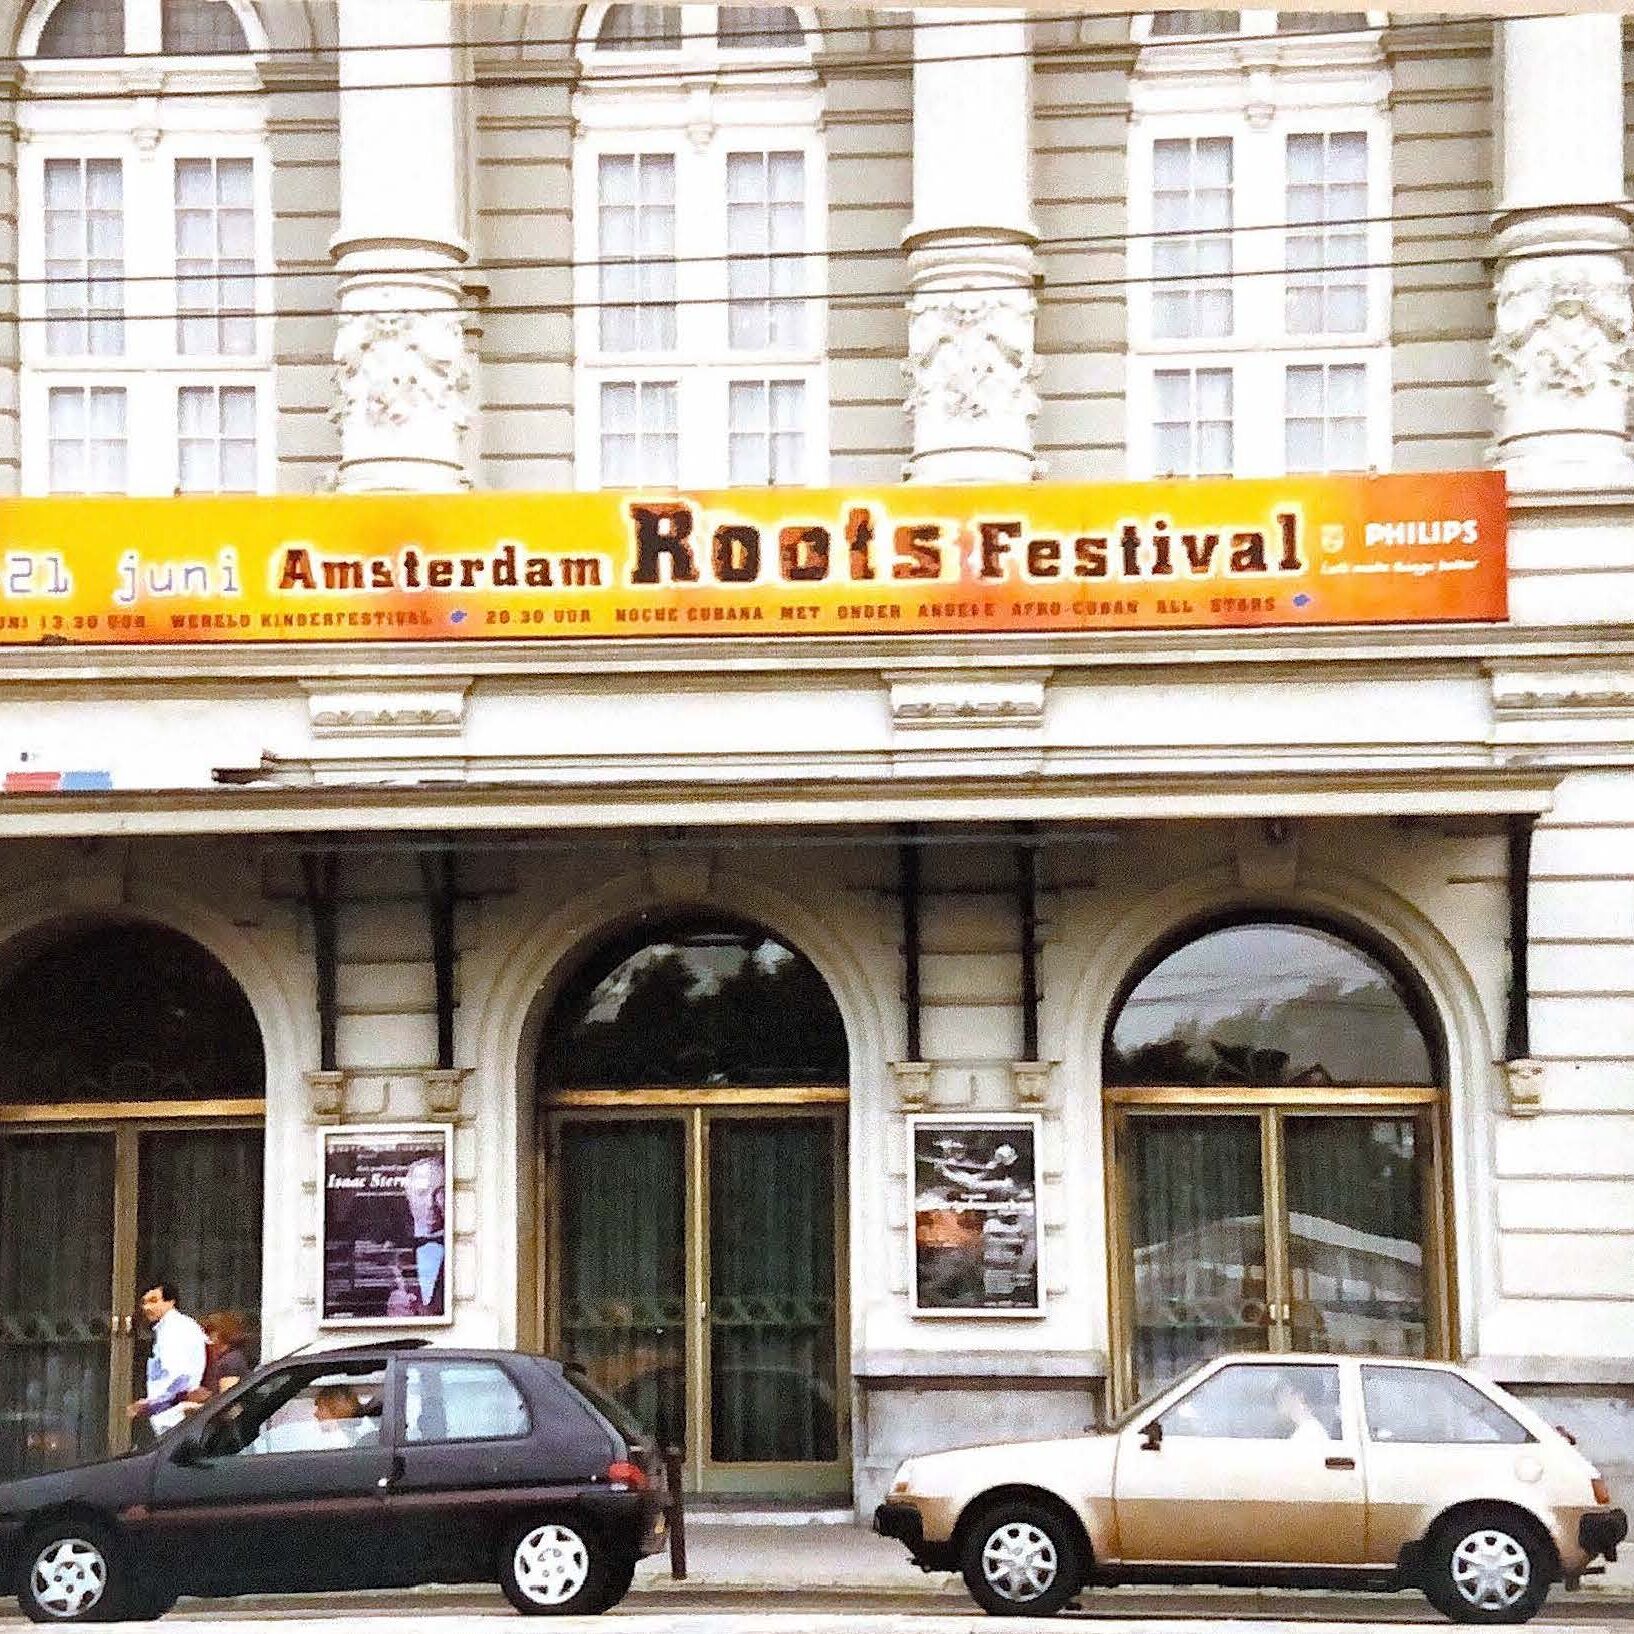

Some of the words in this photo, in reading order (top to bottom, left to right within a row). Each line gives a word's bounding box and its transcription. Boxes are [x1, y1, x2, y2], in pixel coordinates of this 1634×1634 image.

[1365, 520, 1478, 546] PHILIPS
[117, 554, 240, 602] juni
[278, 545, 603, 590] Amsterdam
[629, 502, 942, 583] Roots
[978, 511, 1304, 578] Festival
[615, 607, 679, 623] NOCHE
[686, 605, 764, 622] CUBANA
[780, 605, 822, 621] MET
[1156, 599, 1194, 614] ALL
